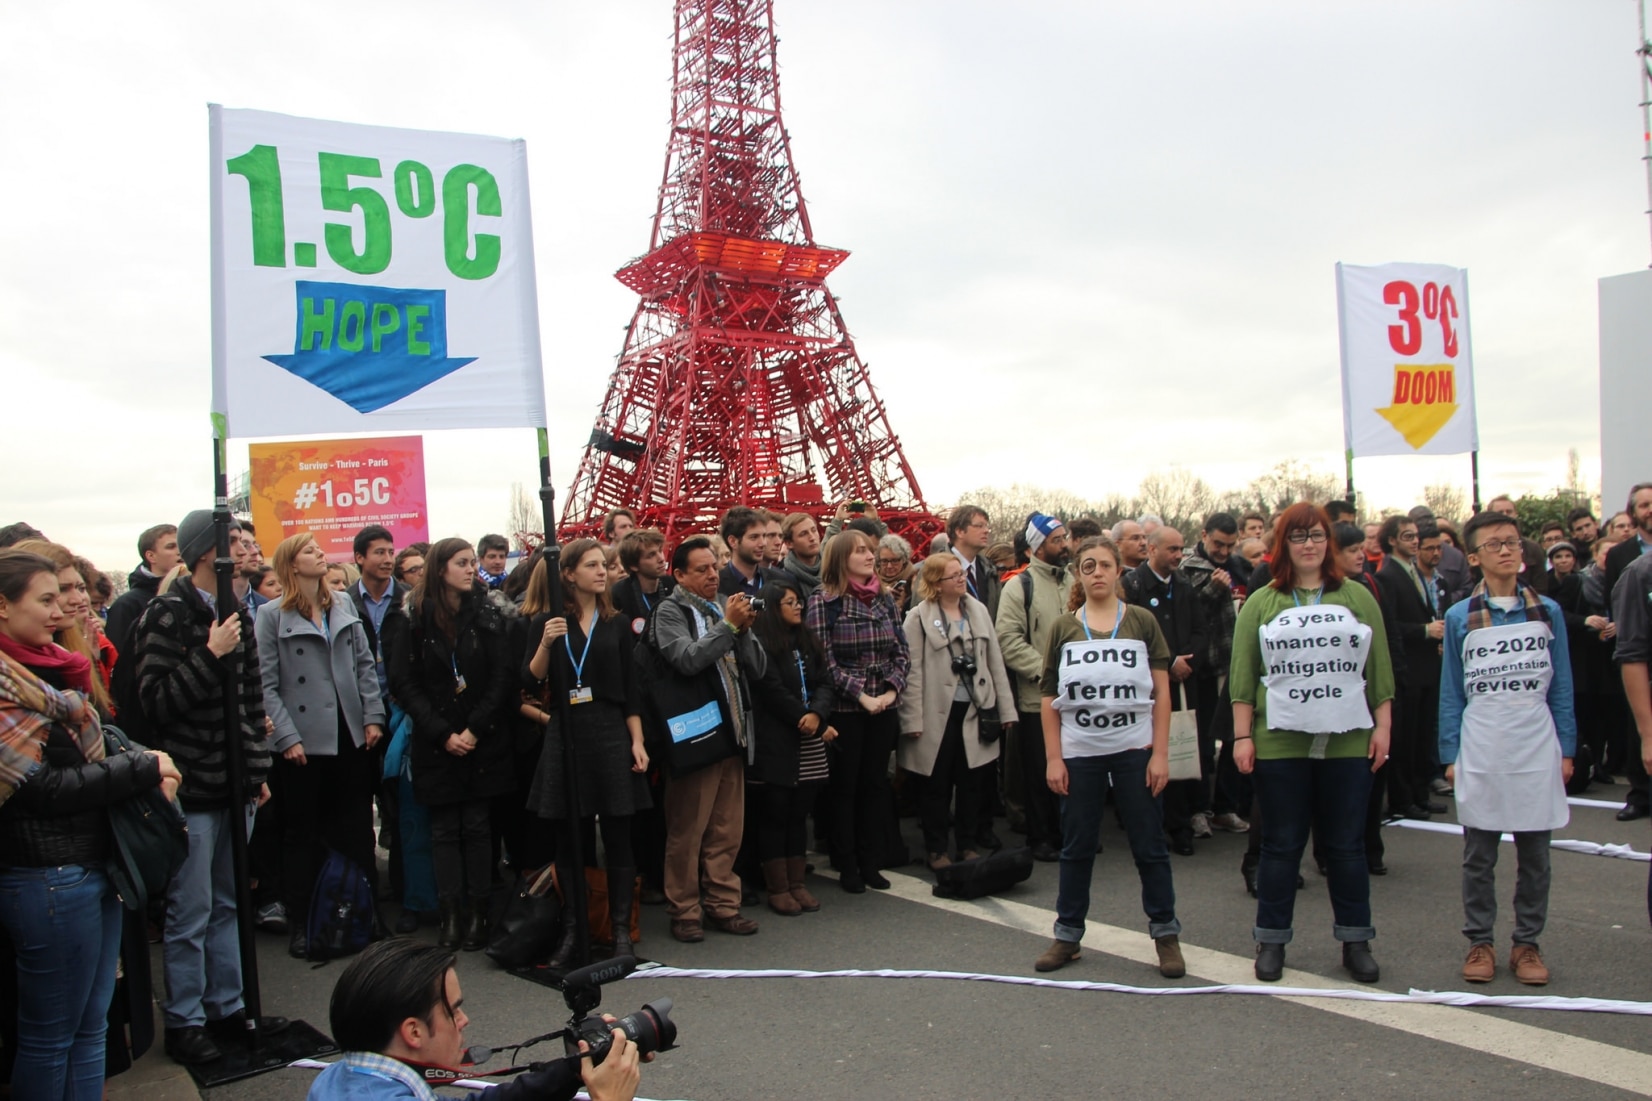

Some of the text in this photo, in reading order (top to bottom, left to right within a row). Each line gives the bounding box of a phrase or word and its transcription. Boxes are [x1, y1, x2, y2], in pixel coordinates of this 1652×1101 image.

[300, 297, 431, 356] HOPE
[1394, 370, 1453, 405] DOOM
[298, 461, 328, 471] Survive
[336, 459, 361, 469] Thrive
[368, 458, 388, 467] Paris
[1279, 613, 1345, 627] 5 year
[1349, 634, 1359, 648] &
[1465, 637, 1546, 661] re-2020
[1066, 648, 1137, 668] Long
[1065, 681, 1136, 700] Term
[1288, 685, 1342, 703] cycle
[1468, 677, 1540, 693] review
[1075, 708, 1136, 728] Goal
[425, 1069, 455, 1078] EOS
